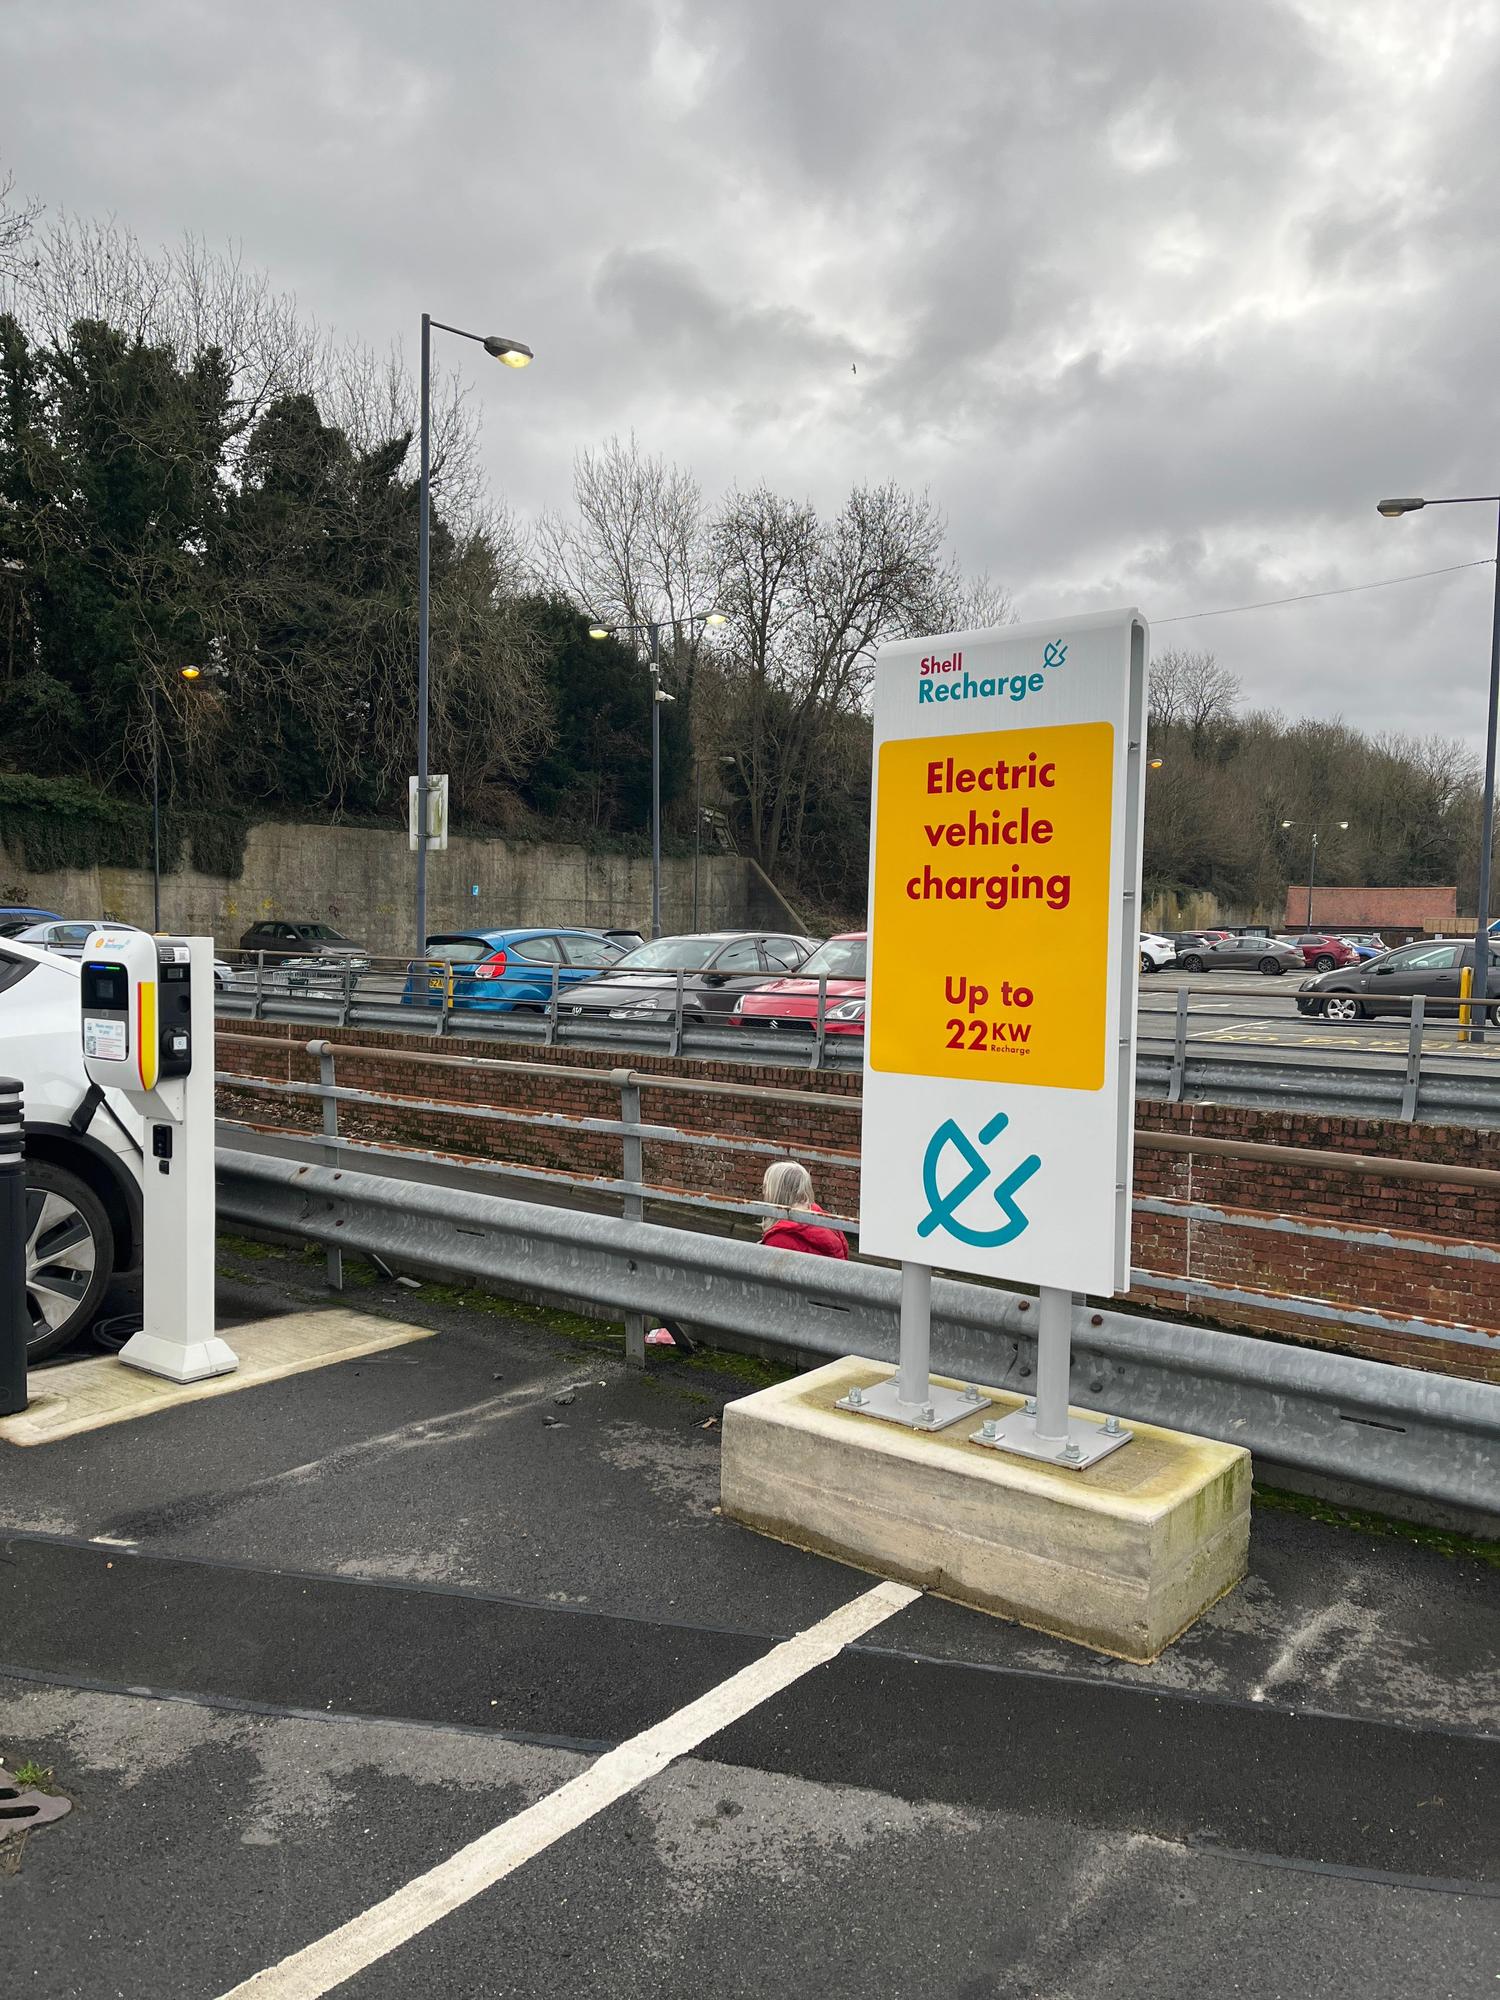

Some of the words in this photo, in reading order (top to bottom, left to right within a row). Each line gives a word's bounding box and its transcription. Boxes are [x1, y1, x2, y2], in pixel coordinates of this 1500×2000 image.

[919, 652, 962, 676] Shell
[918, 671, 1044, 704] Recharge
[927, 751, 1056, 795] Electric
[924, 807, 1054, 847] vehicle
[906, 864, 1071, 910] charging
[945, 975, 989, 1014] Up
[1001, 981, 1034, 1008] to
[990, 1044, 1031, 1056] Recharge
